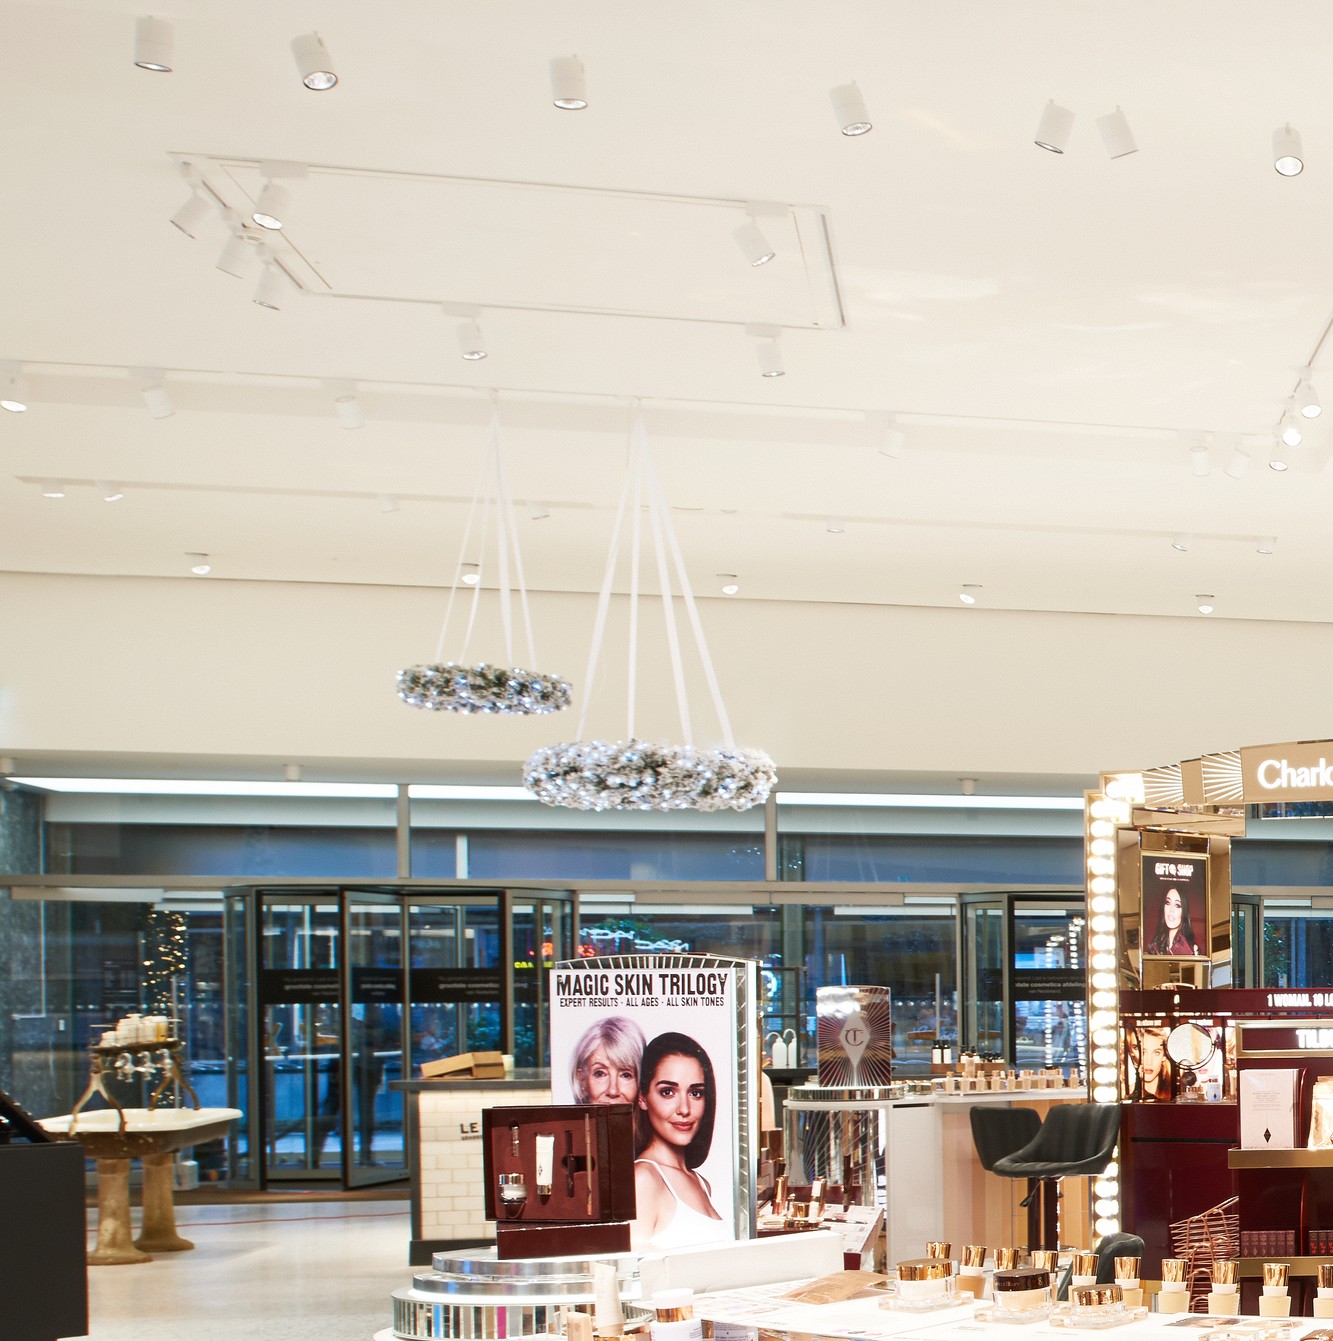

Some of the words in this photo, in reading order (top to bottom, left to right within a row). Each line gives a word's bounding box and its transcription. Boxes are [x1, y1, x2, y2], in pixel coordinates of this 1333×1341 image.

[556, 974, 609, 996] MAGIC
[614, 974, 653, 996] SKIN
[659, 973, 728, 996] TRILOGY
[560, 998, 586, 1007] EXPERT
[589, 998, 619, 1007] RESULTS
[626, 998, 639, 1007] ALL
[641, 998, 659, 1007] AGES
[666, 998, 679, 1007] ALL
[681, 997, 698, 1006] SKIN
[701, 997, 724, 1006] TONES
